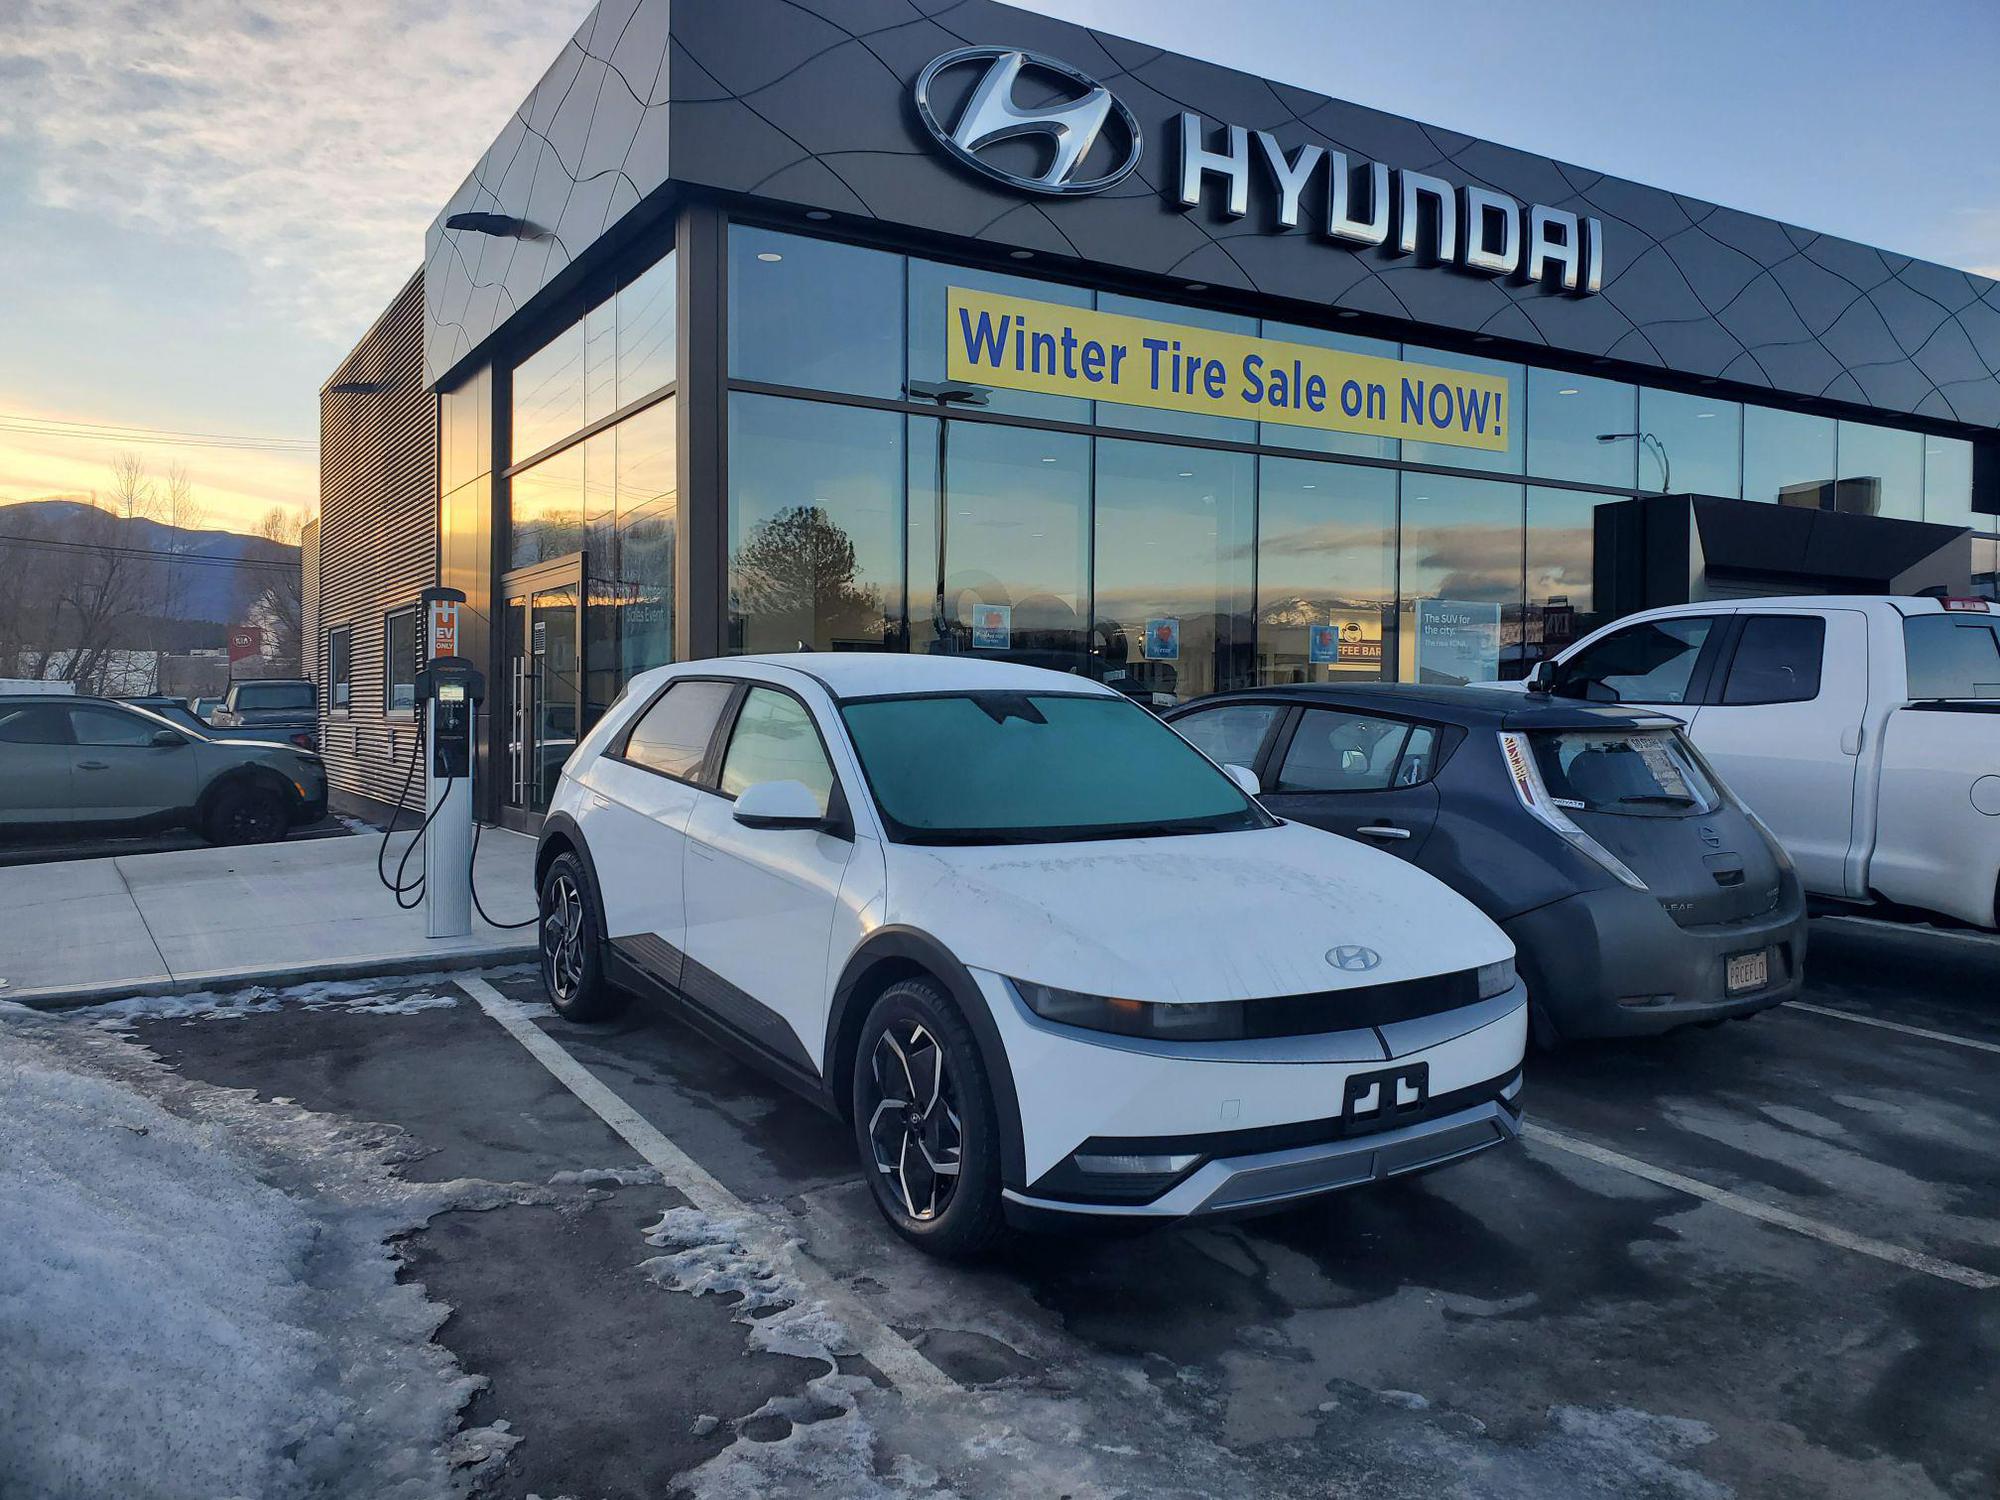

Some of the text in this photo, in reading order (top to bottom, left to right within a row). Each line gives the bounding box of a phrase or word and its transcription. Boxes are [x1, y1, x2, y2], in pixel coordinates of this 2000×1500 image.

[1178, 111, 1604, 296] HYUNDAI
[958, 307, 1503, 437] Winter Tire Sale on NOW!
[1424, 613, 1472, 625] The SUV for
[436, 627, 454, 639] EV
[1424, 625, 1439, 635] the
[436, 642, 454, 650] ONLY
[1338, 646, 1360, 656] FFEE
[1361, 646, 1382, 657] BAR
[1662, 903, 1695, 912] LEAF
